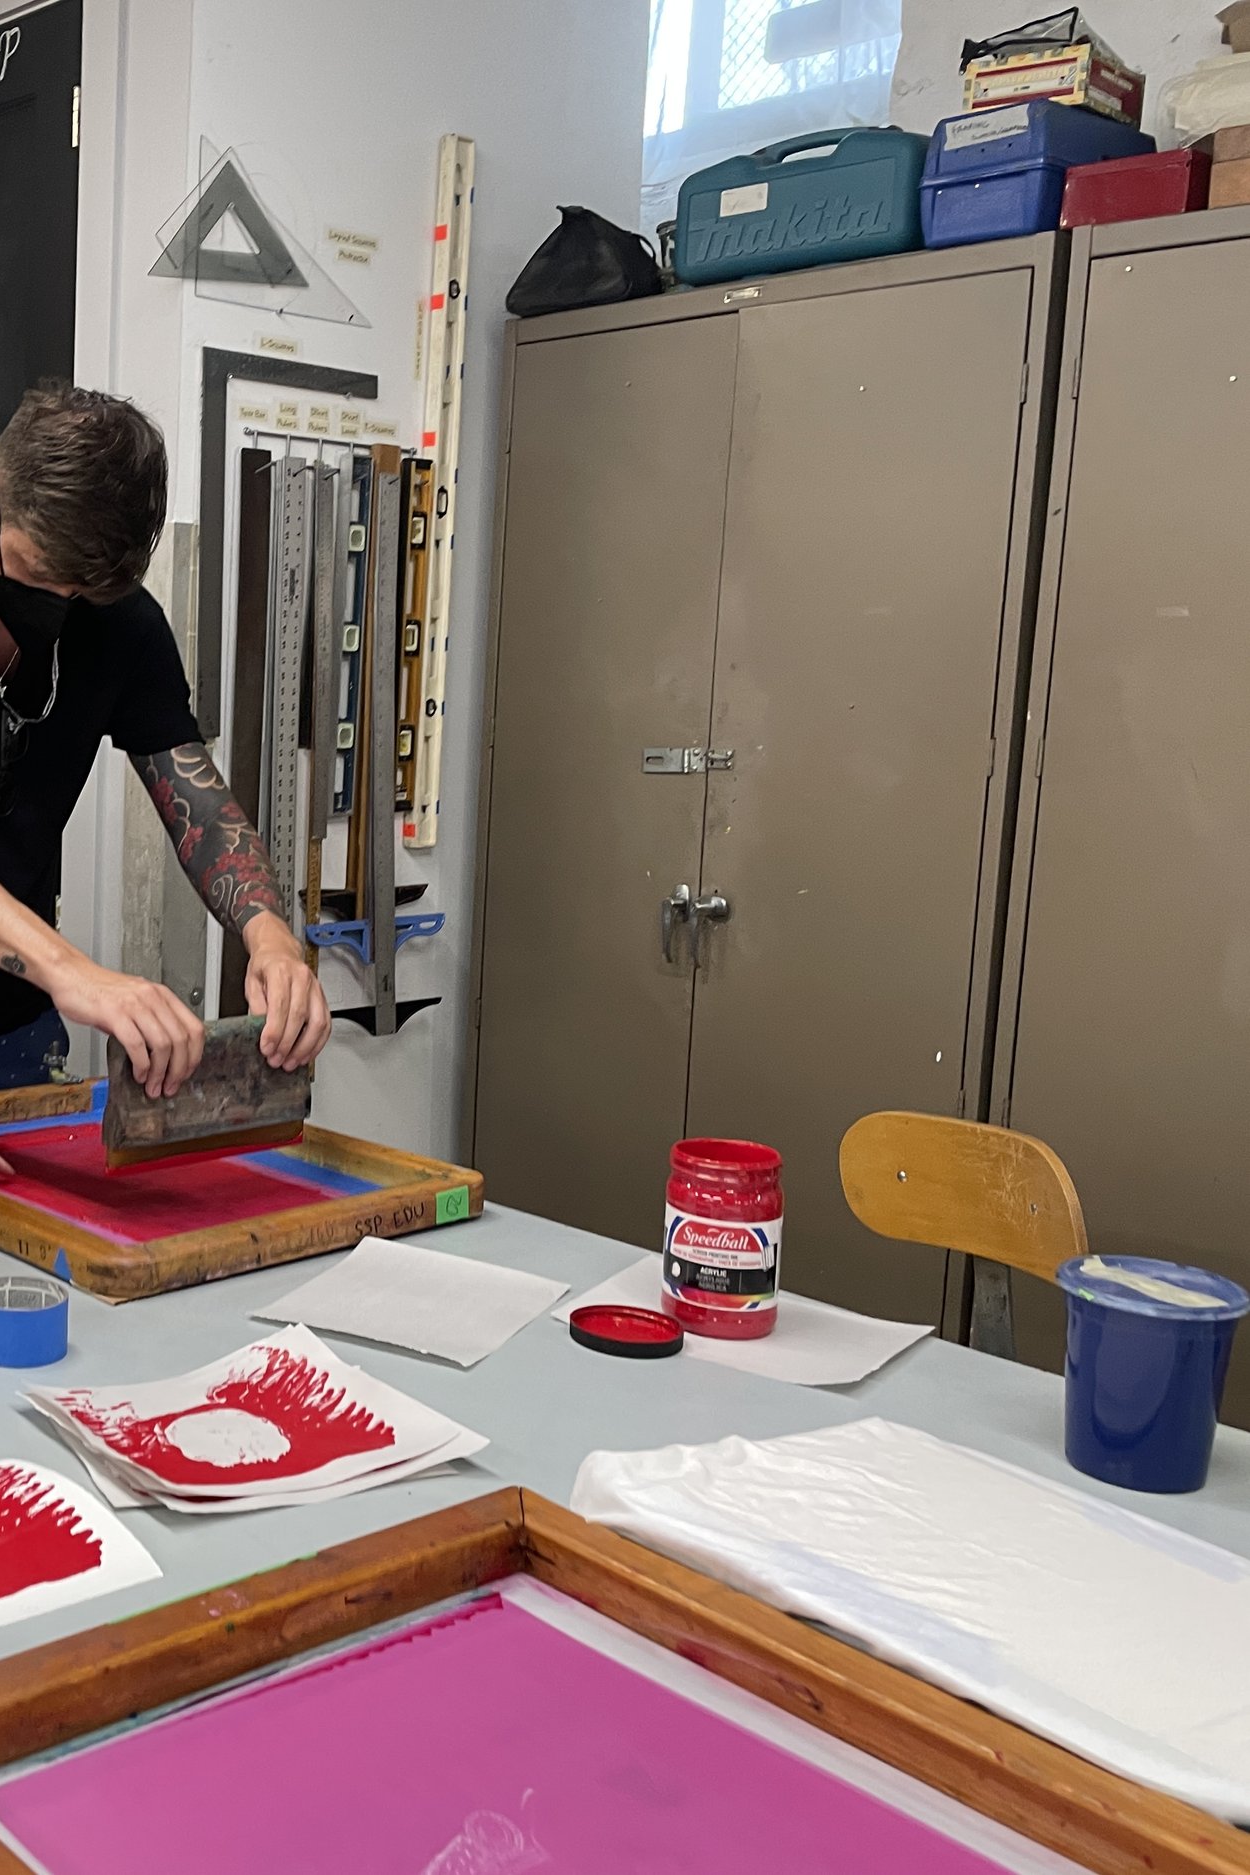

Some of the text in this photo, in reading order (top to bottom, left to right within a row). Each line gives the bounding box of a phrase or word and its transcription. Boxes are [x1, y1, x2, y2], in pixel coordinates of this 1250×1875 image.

[688, 195, 890, 263] makita
[355, 1214, 383, 1238] SSP
[393, 1202, 425, 1231] EDU
[683, 1226, 750, 1250] Speedball
[699, 1266, 727, 1278] ACRYLIC
